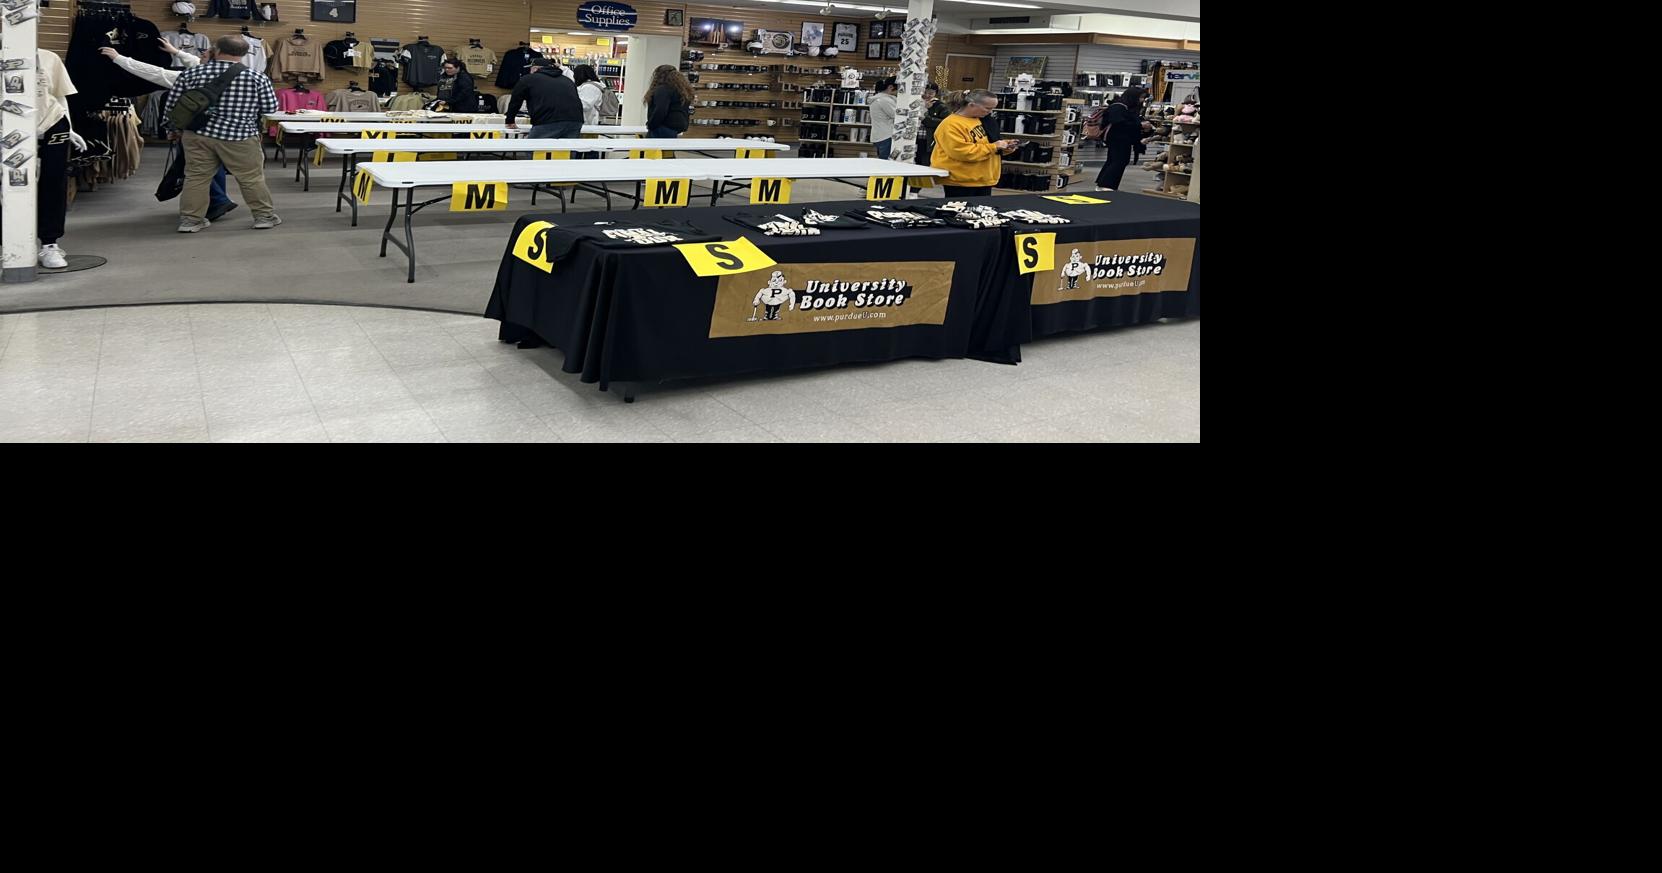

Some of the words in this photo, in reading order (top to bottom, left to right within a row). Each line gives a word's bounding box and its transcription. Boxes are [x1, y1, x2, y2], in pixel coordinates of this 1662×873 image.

[591, 5, 626, 16] Office
[585, 14, 630, 27] Supplies
[464, 183, 496, 209] M
[654, 180, 680, 204] M
[758, 180, 782, 202] M
[873, 178, 893, 199] M
[528, 228, 549, 260] S
[704, 244, 744, 270] S
[1022, 237, 1039, 268] S
[1095, 252, 1163, 266] University
[1071, 263, 1079, 271] P
[1128, 265, 1162, 278] Store
[770, 289, 782, 298] P
[806, 278, 906, 293] University
[800, 294, 849, 310] Book
[855, 293, 904, 307] Store
[813, 311, 887, 323] www.purdueU.com
